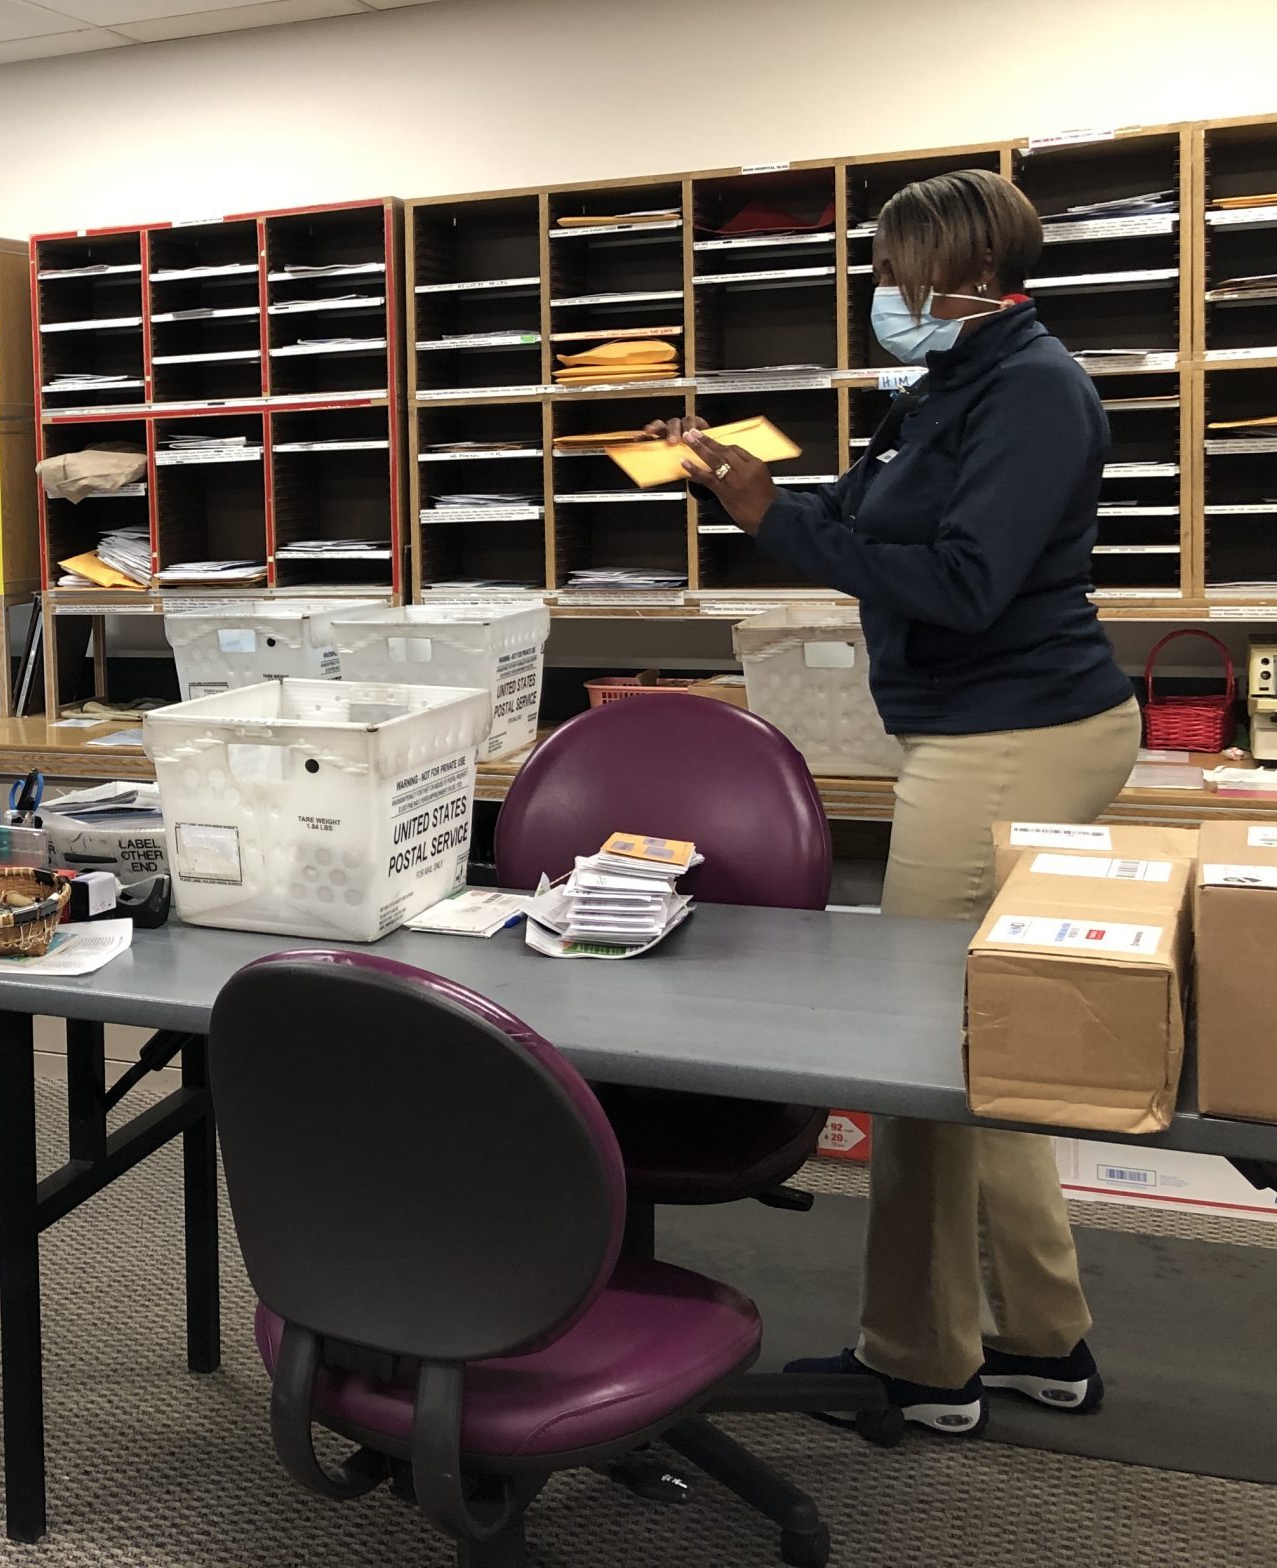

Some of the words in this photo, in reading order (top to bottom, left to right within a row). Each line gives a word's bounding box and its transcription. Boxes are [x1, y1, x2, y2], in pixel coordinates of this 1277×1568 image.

[496, 680, 516, 699] UNITED
[517, 673, 536, 692] STATES
[493, 699, 514, 719] POSTAL
[516, 691, 537, 711] SERVICE
[396, 775, 418, 791] WARNING
[421, 770, 430, 782] NOT
[431, 766, 439, 777] FOR
[440, 760, 457, 773] PRIVATE
[393, 812, 429, 845] UNITED
[432, 796, 467, 828] STATES
[121, 850, 164, 861] OTHER
[388, 841, 428, 878] POSTAL
[430, 821, 468, 857] SERVICE
[131, 862, 158, 872] END
